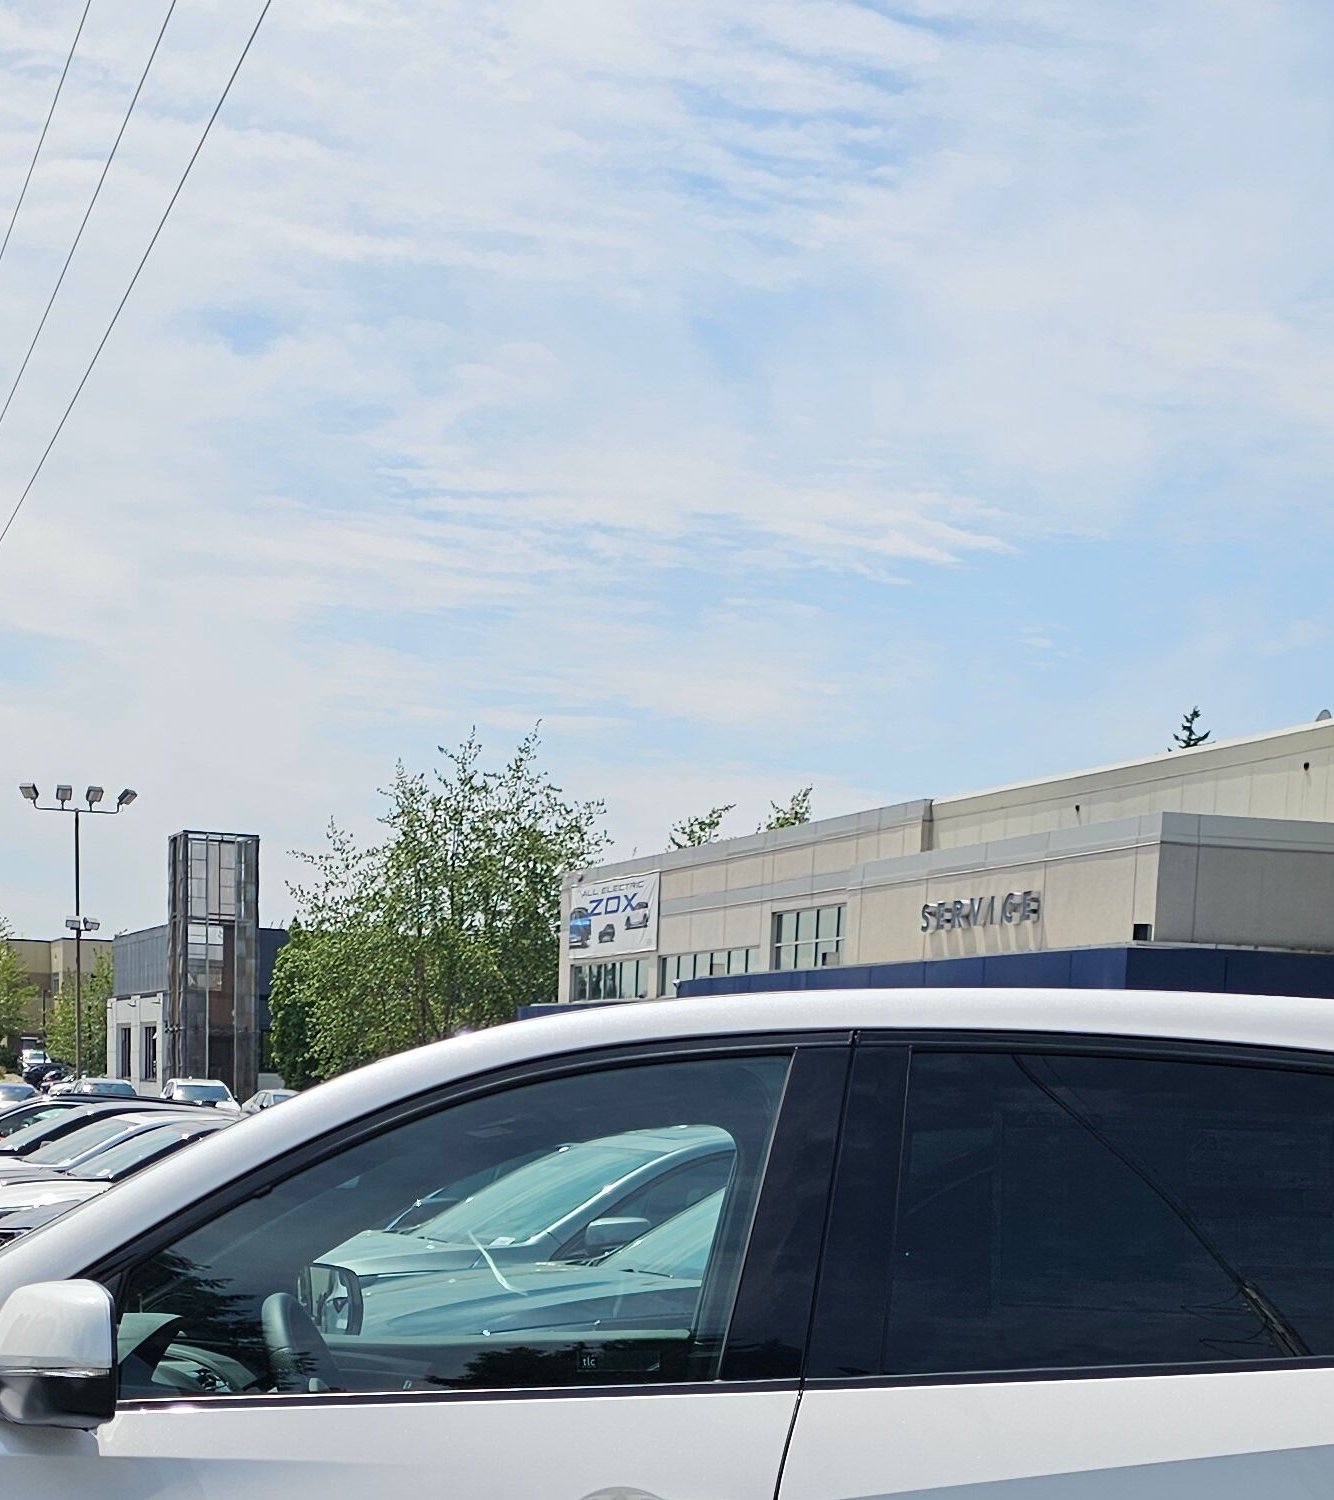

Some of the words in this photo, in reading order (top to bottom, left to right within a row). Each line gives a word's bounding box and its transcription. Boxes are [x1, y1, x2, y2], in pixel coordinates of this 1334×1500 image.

[581, 889, 599, 898] ALL
[601, 881, 645, 895] ELECTRIC
[587, 893, 639, 917] ZDX
[921, 890, 1040, 933] SERVICE
